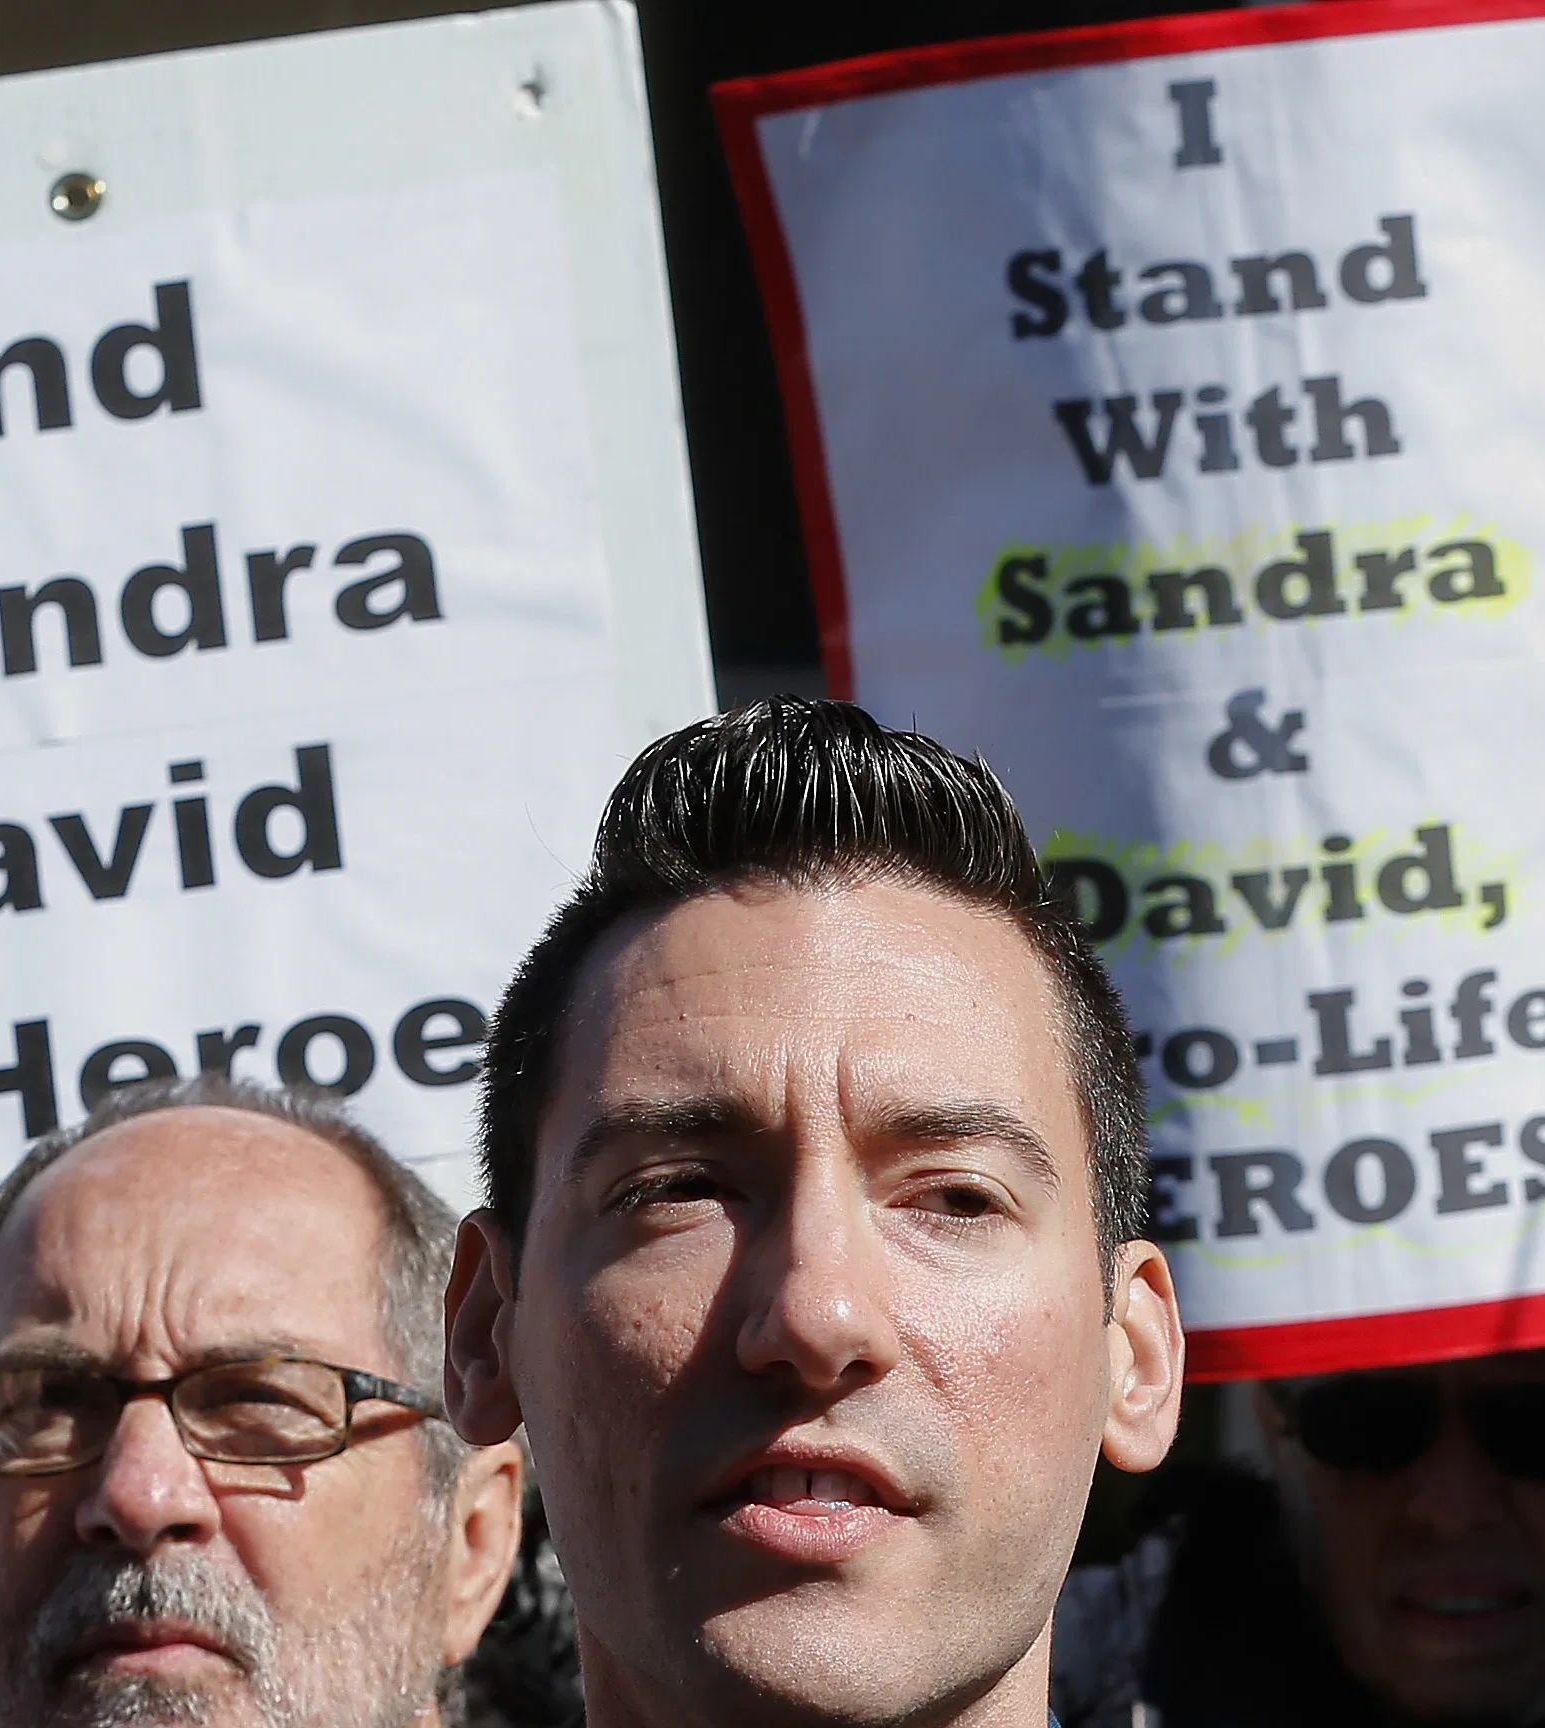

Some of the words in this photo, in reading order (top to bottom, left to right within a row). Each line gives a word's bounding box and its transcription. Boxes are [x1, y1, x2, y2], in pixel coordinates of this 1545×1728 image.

[1168, 80, 1221, 169] I
[1007, 215, 1428, 341] Stand
[1057, 377, 1404, 488] With
[996, 530, 1507, 646] Sandra
[1206, 687, 1311, 781] &
[1046, 823, 1509, 944] David,
